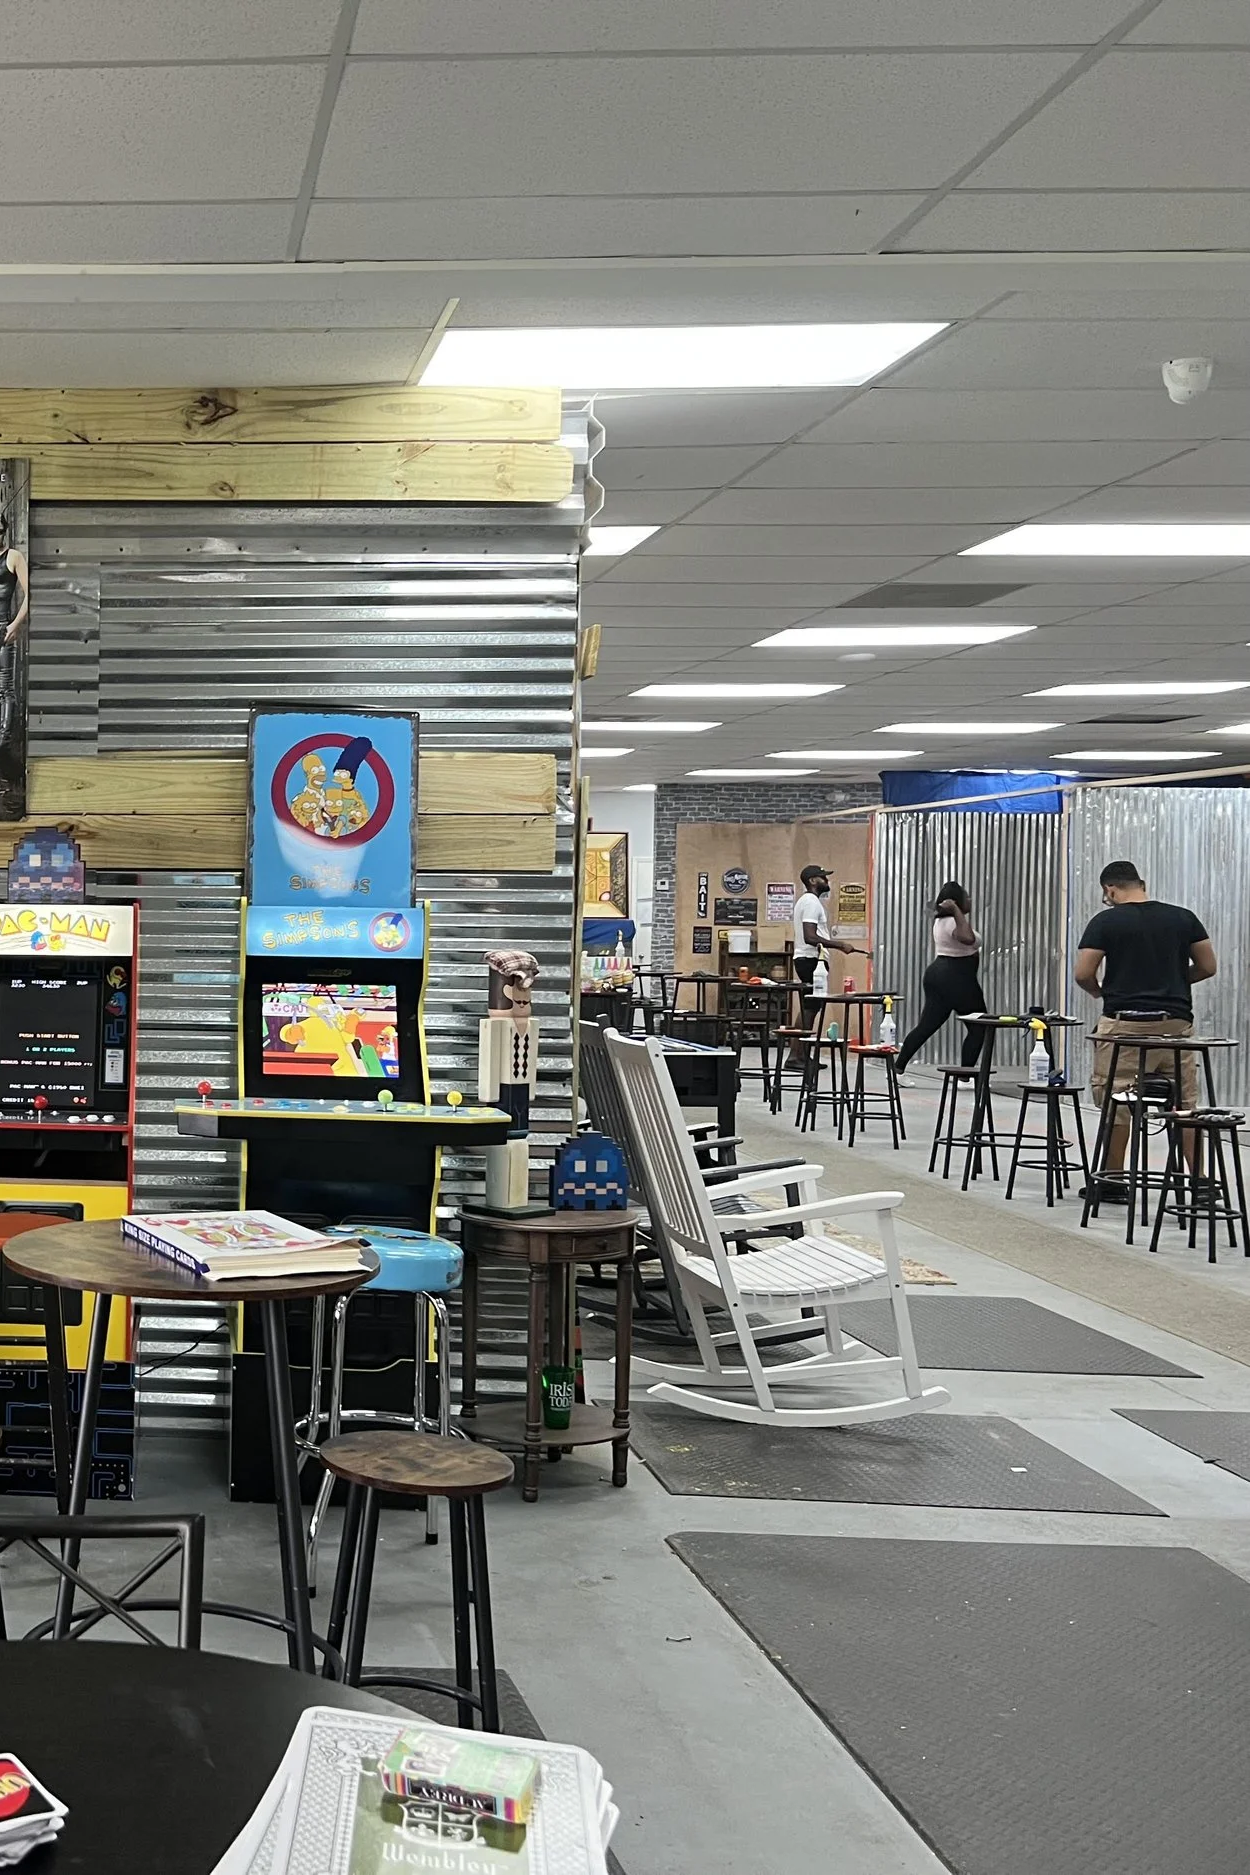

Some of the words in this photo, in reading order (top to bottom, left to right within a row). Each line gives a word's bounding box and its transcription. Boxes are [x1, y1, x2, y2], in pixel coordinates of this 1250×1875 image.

[289, 874, 371, 895] SIMPSONS
[699, 877, 708, 911] BAIT
[283, 910, 325, 928] THE
[262, 920, 361, 950] SIMPSONS
[124, 1222, 138, 1239] KING
[138, 1229, 151, 1246] SIZE
[151, 1236, 176, 1259] PLAYING
[175, 1249, 197, 1270] CARDS
[420, 1787, 488, 1810] AUDREY
